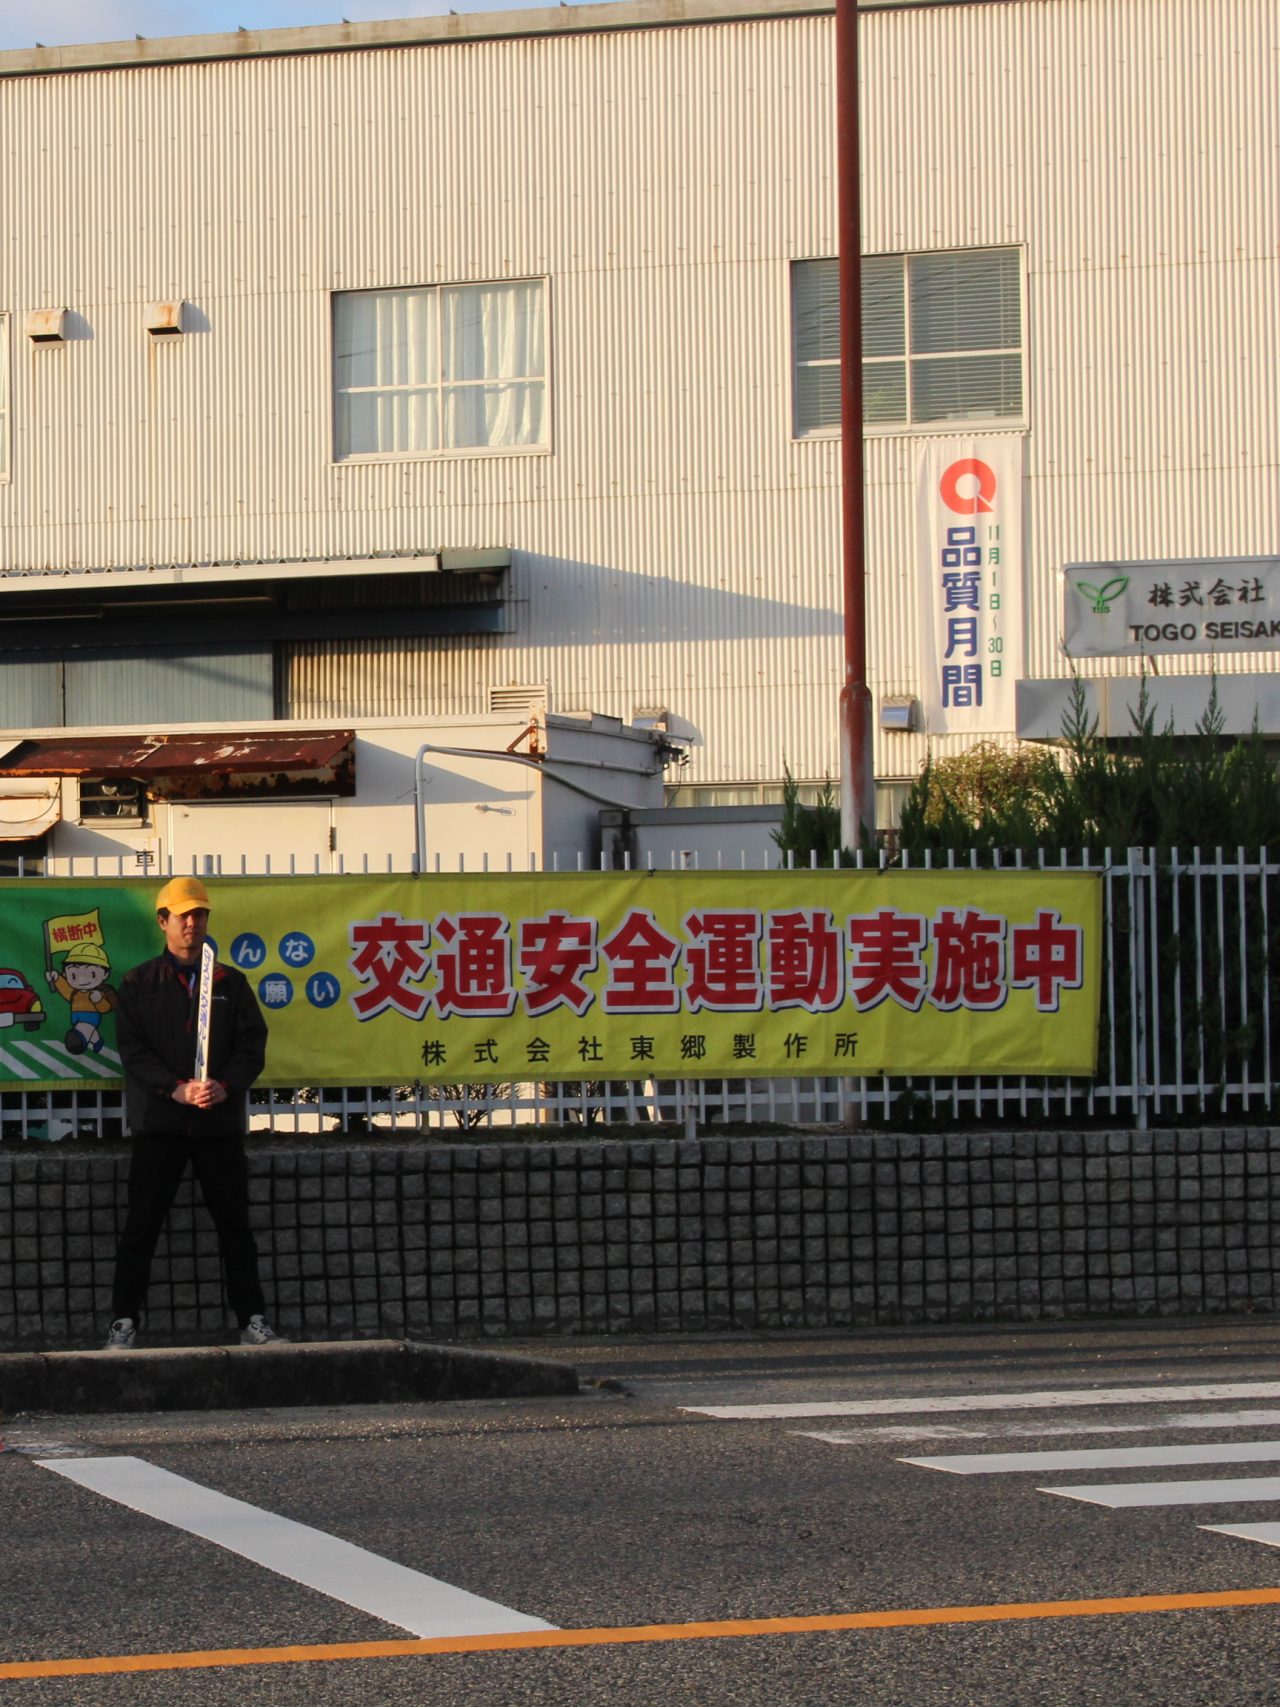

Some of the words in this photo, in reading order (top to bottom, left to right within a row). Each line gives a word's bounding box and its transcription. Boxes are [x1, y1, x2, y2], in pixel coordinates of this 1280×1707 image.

[940, 458, 996, 515] Q
[1148, 577, 1266, 608] 株式会社
[941, 526, 983, 708] 品質月間
[1129, 622, 1197, 642] TOGO
[1205, 619, 1280, 639] SEISAK
[52, 922, 97, 943] 横断中
[349, 907, 1083, 1021] 交通安全運動実施中
[422, 1033, 857, 1066] 株式会社東郷製作所
